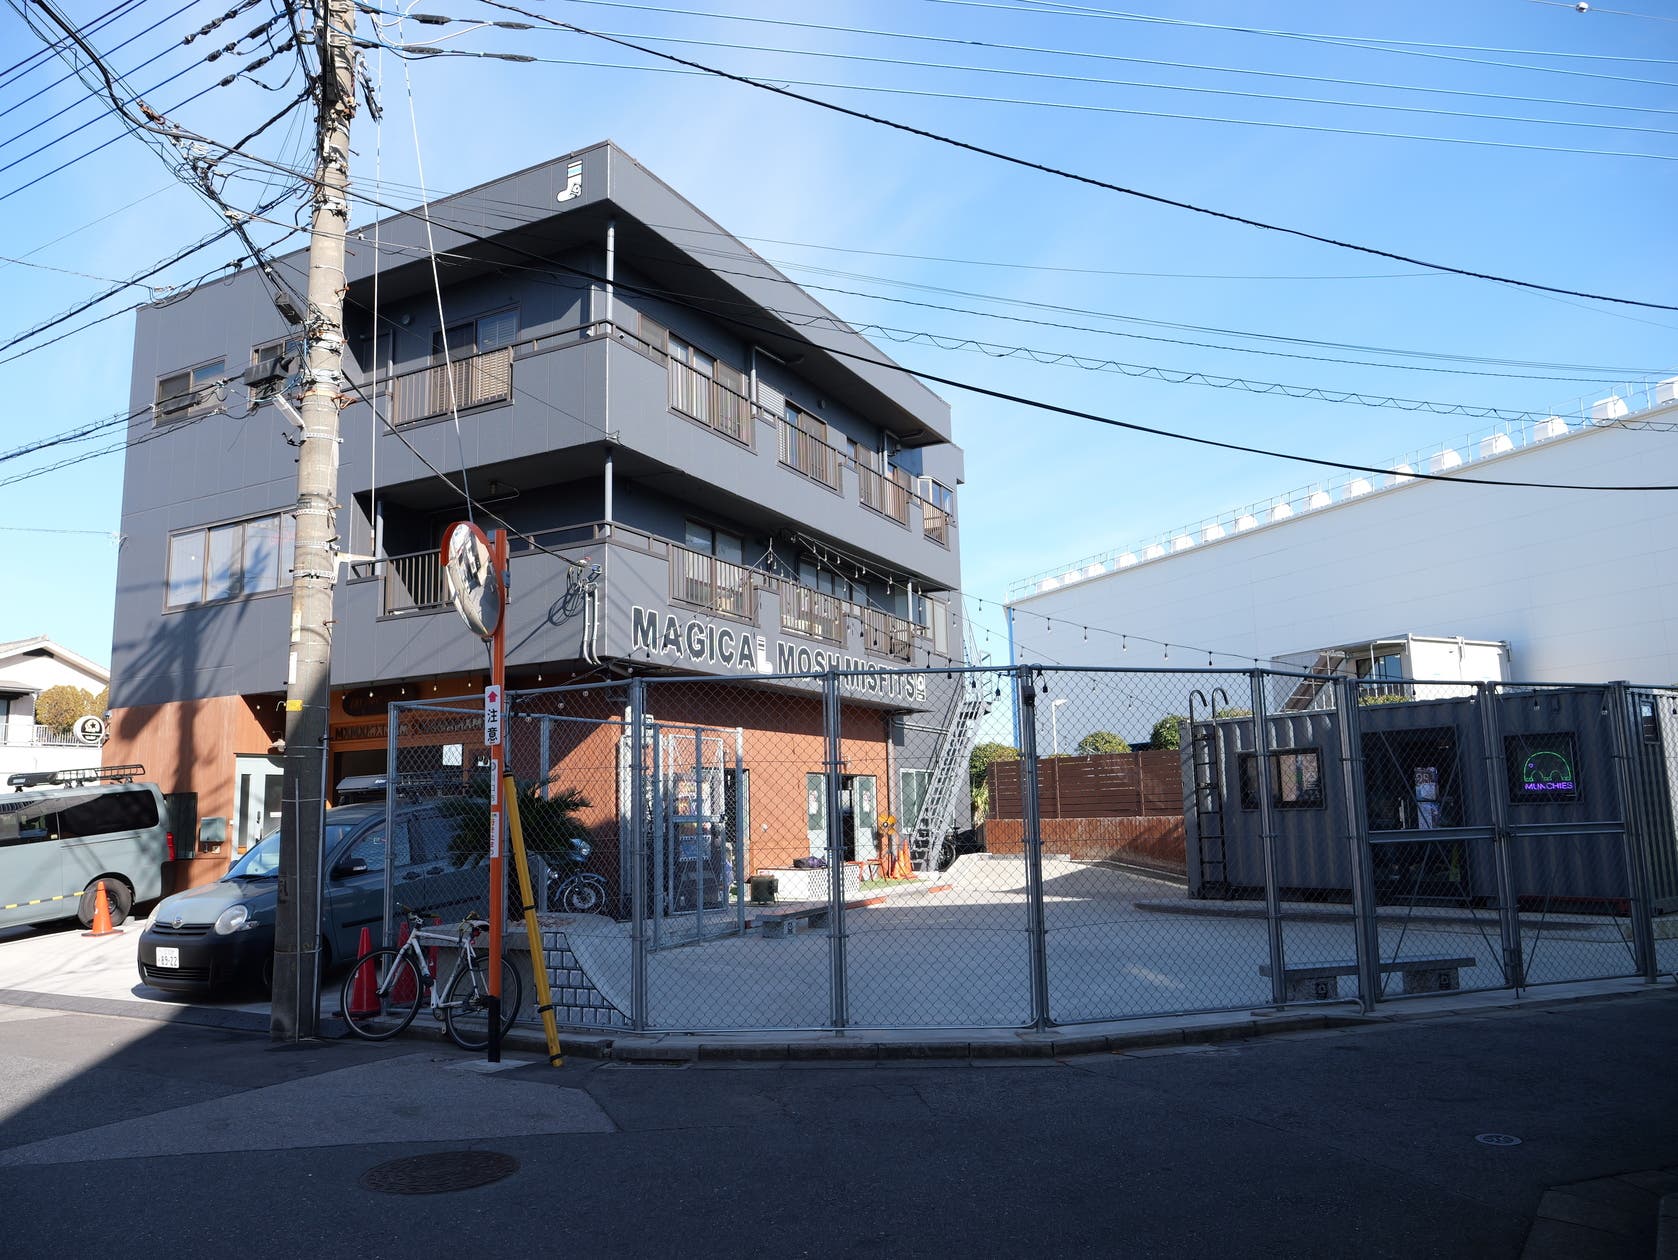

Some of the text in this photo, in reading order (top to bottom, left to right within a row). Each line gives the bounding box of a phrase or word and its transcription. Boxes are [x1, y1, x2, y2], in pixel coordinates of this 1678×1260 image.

[777, 641, 841, 686] MOSH
[487, 708, 498, 743] 注意
[1524, 781, 1574, 791] MUNCHIES
